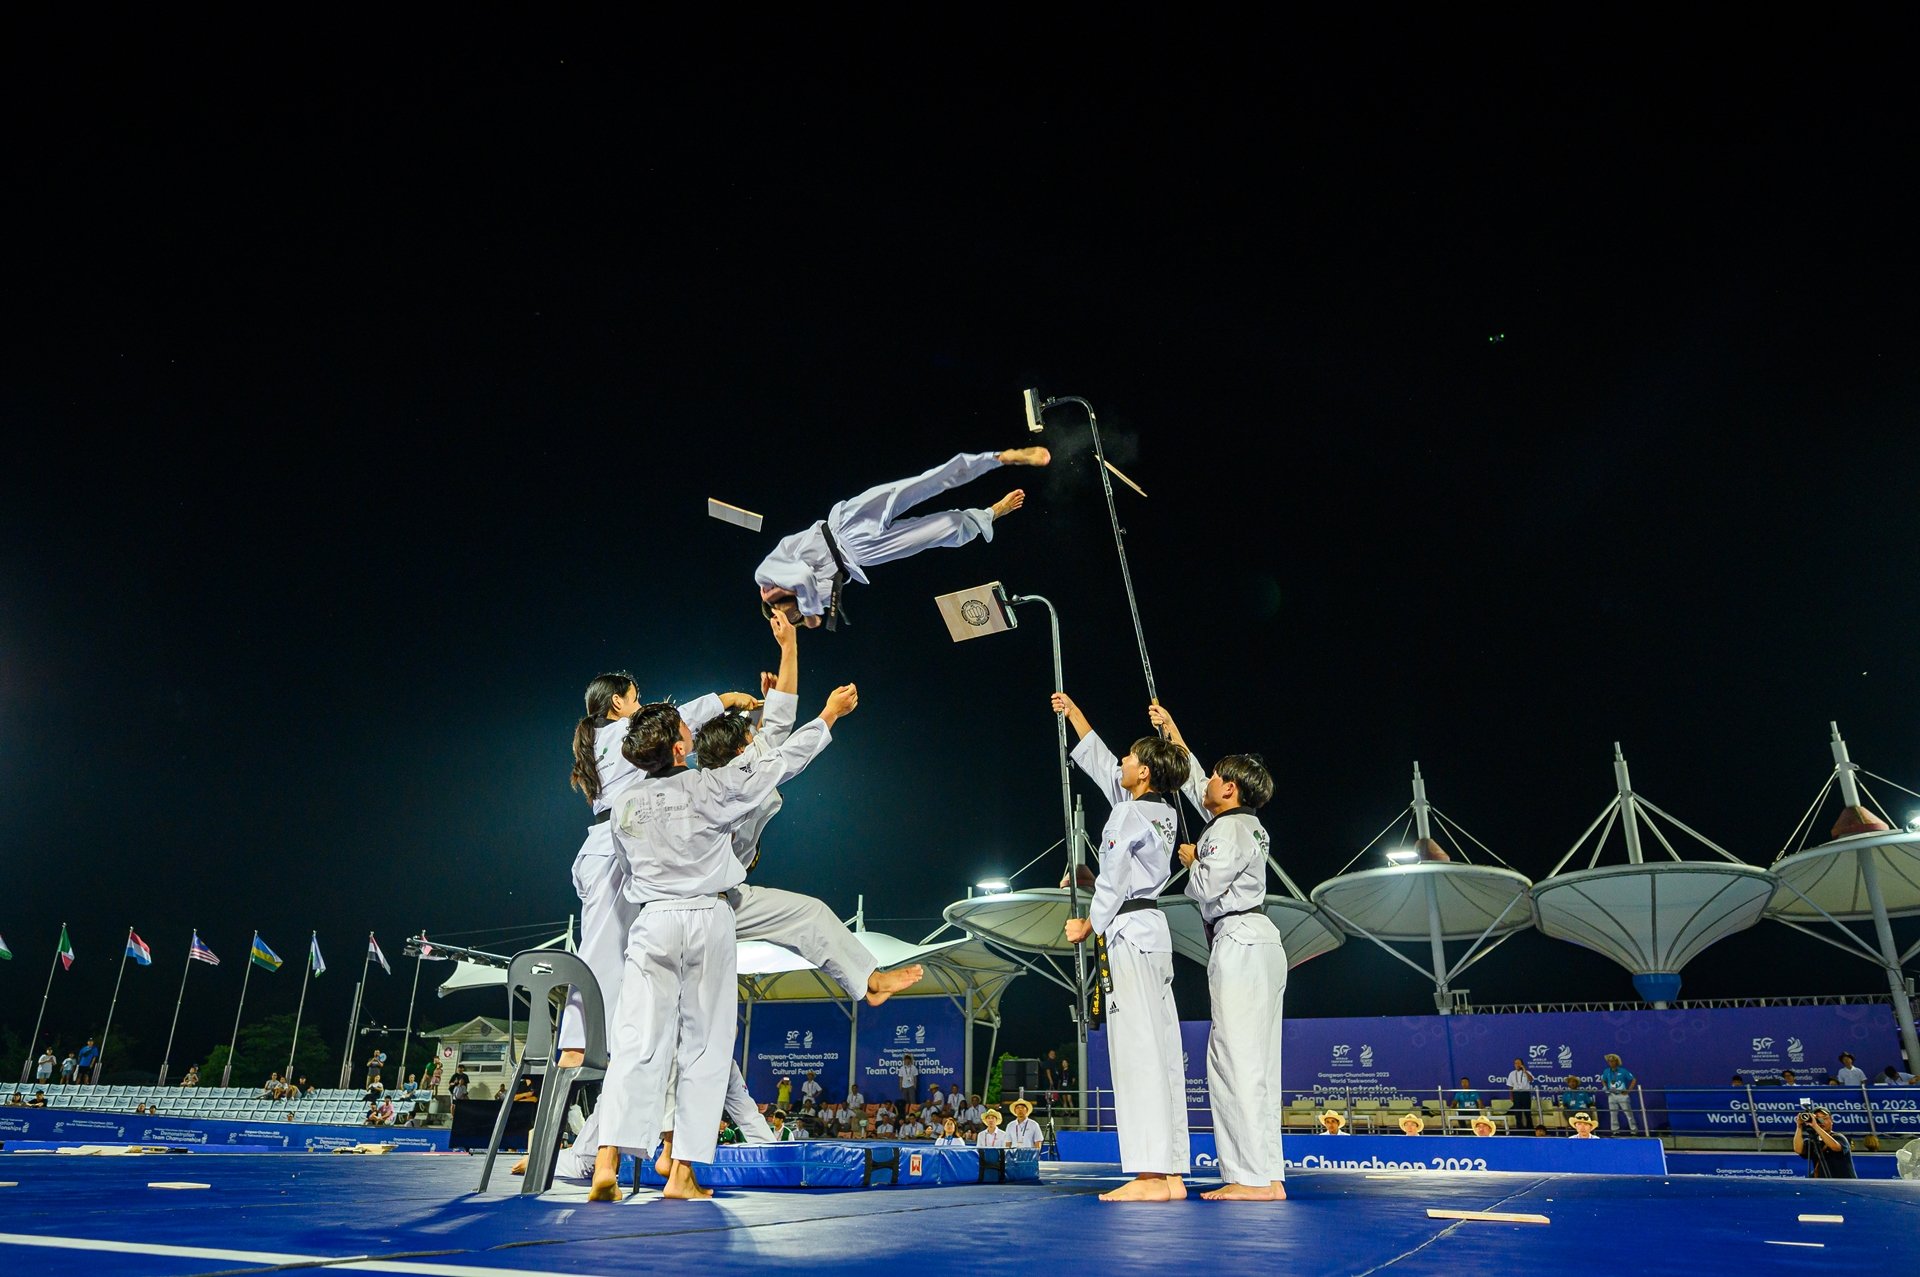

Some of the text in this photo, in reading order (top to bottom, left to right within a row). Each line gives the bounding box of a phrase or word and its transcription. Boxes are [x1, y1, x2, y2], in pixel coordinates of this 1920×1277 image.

[757, 1052, 839, 1061] Gangwon-Chuncheon 2023
[865, 1067, 888, 1075] Team
[1881, 1099, 1917, 1110] 2023
[1707, 1112, 1747, 1124] World
[1431, 1157, 1488, 1172] 2023
